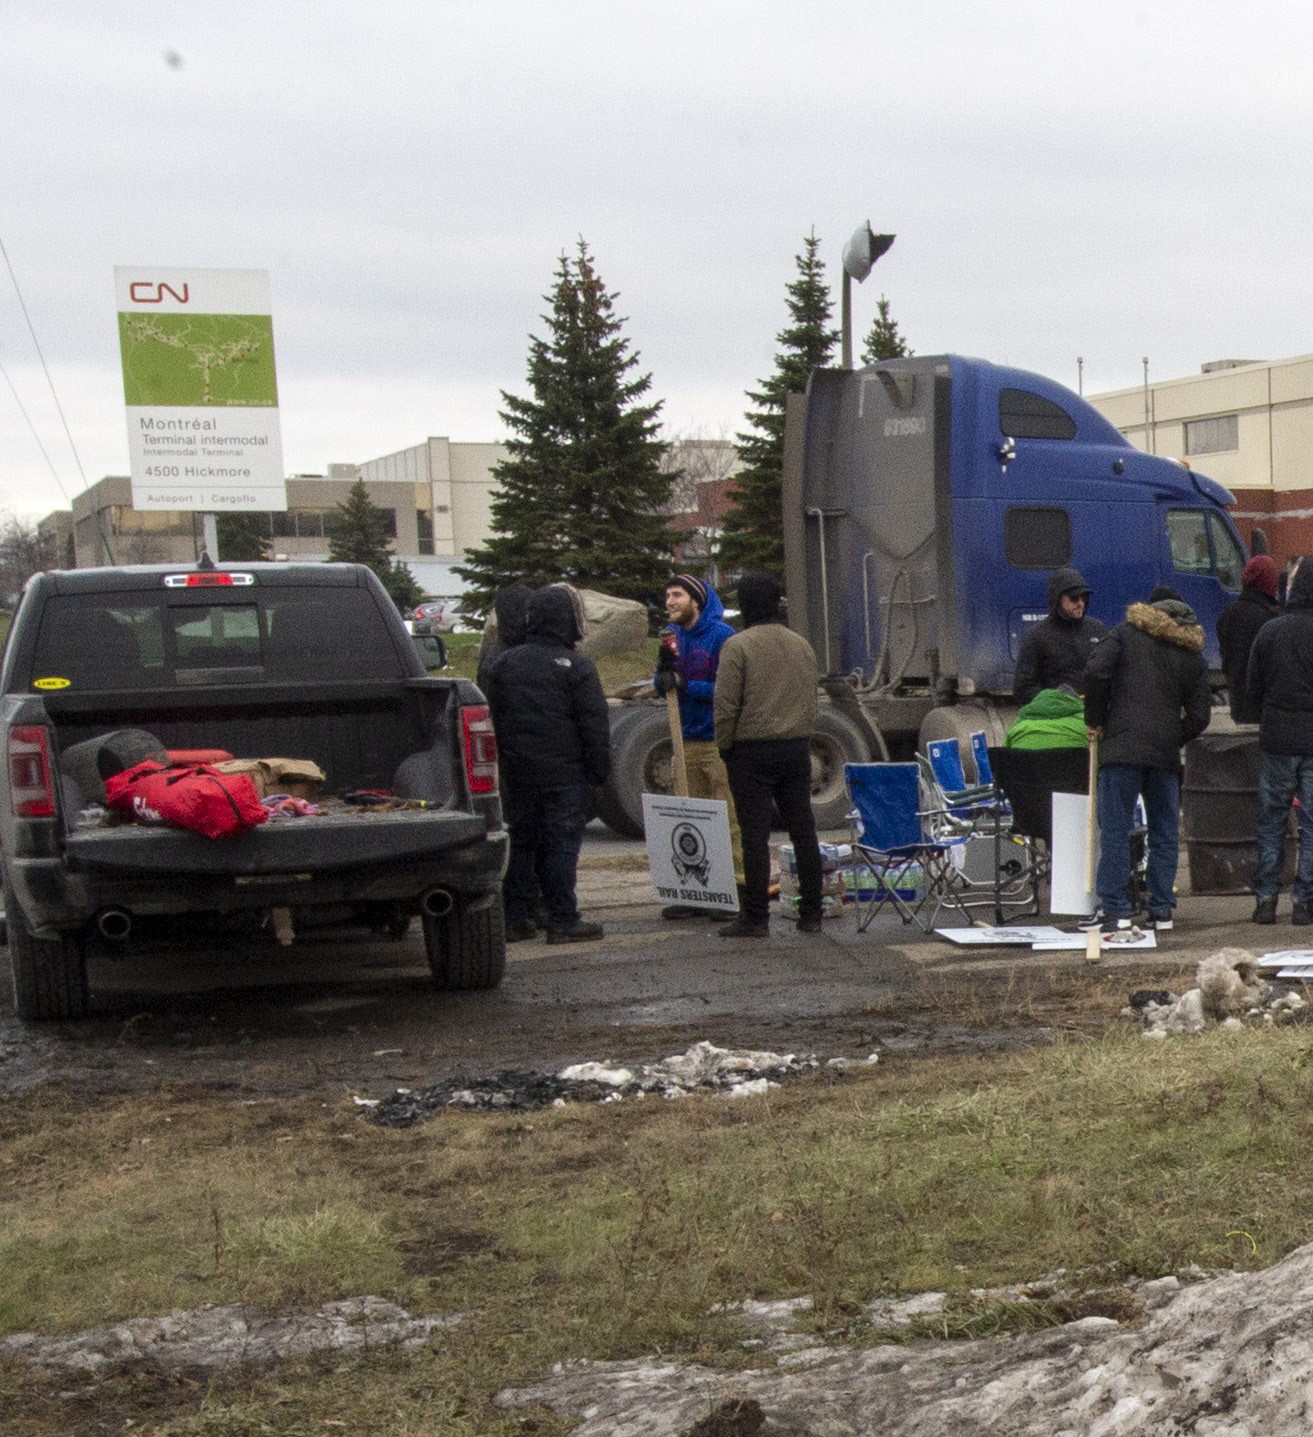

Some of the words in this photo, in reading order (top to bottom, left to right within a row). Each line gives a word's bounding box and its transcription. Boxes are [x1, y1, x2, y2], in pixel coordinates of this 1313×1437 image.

[130, 282, 189, 303] CN
[140, 417, 217, 430] Montréal
[142, 434, 197, 446] Terminal
[201, 434, 268, 446] intermodal
[145, 466, 179, 477] 4500
[184, 465, 251, 477] Hickmore
